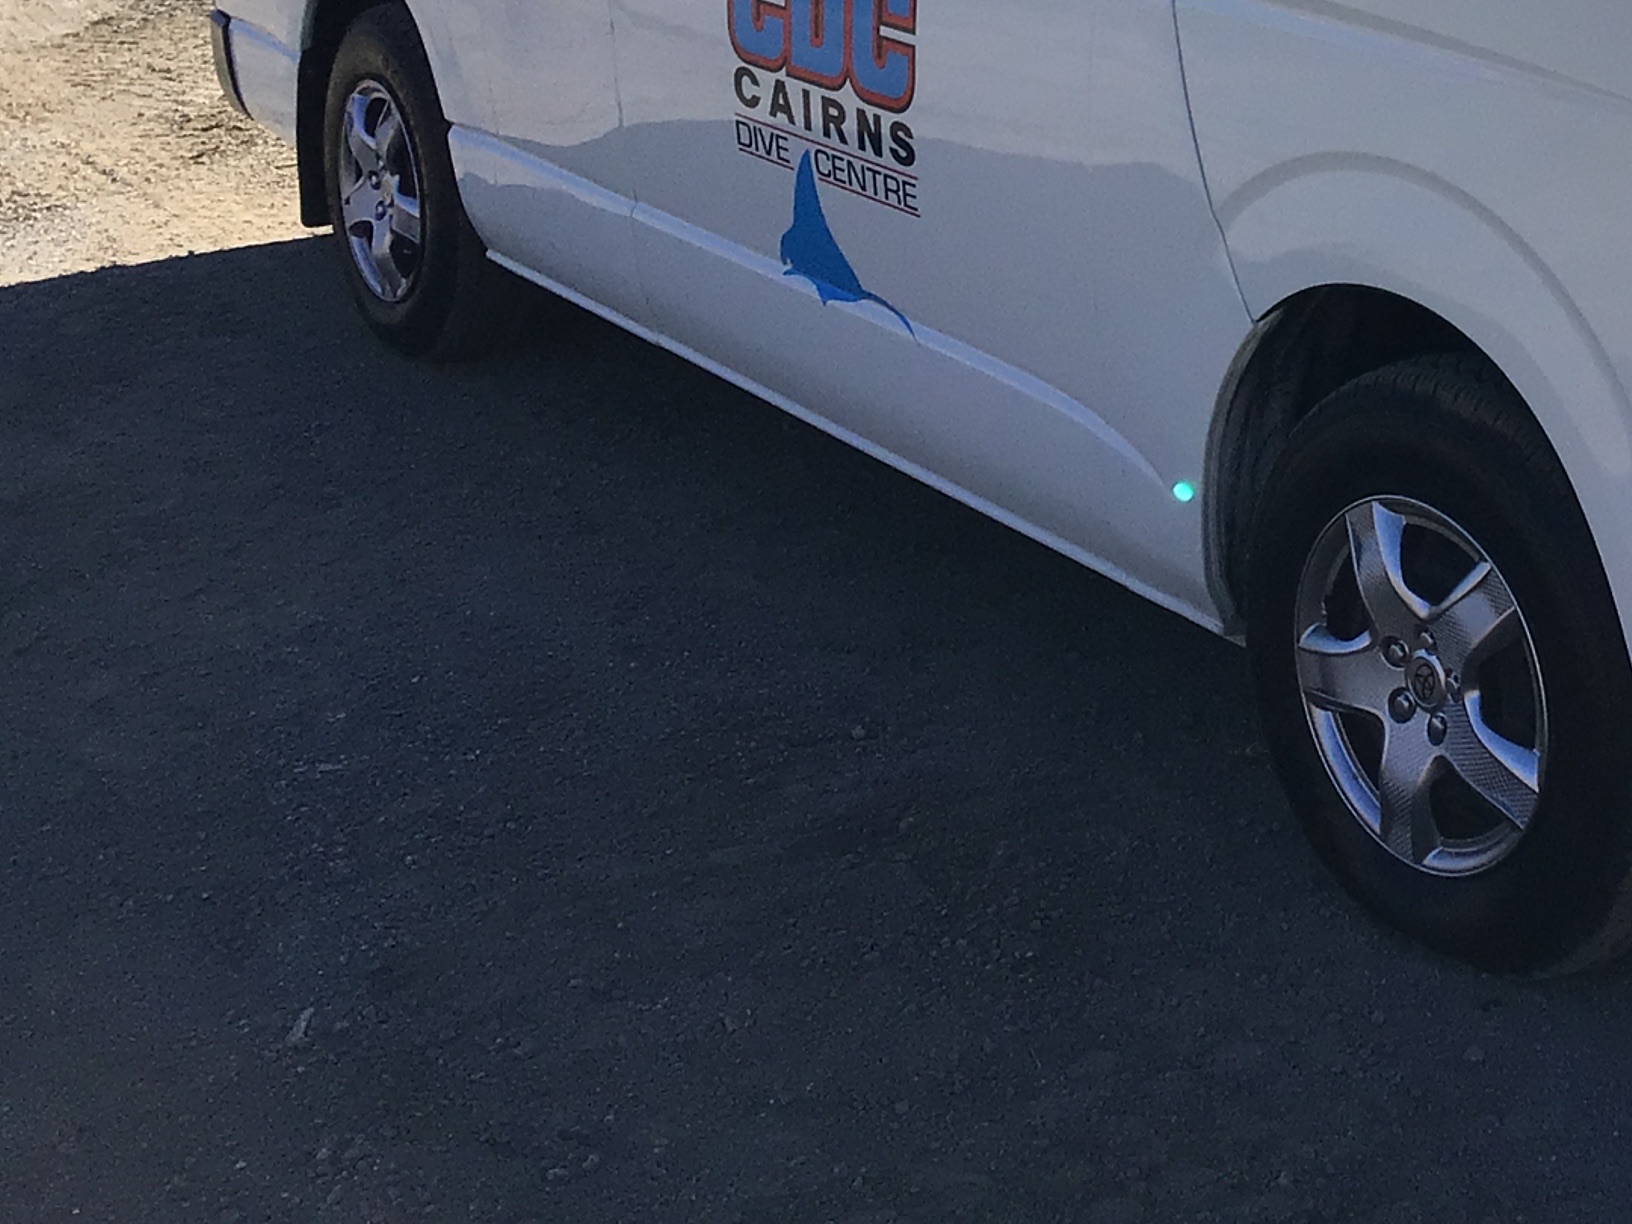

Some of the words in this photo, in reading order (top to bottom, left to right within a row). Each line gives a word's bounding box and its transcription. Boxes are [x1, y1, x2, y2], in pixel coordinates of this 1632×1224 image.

[733, 66, 917, 168] CAIRNS
[735, 120, 791, 165] DIVE
[813, 148, 919, 213] CENTRE
